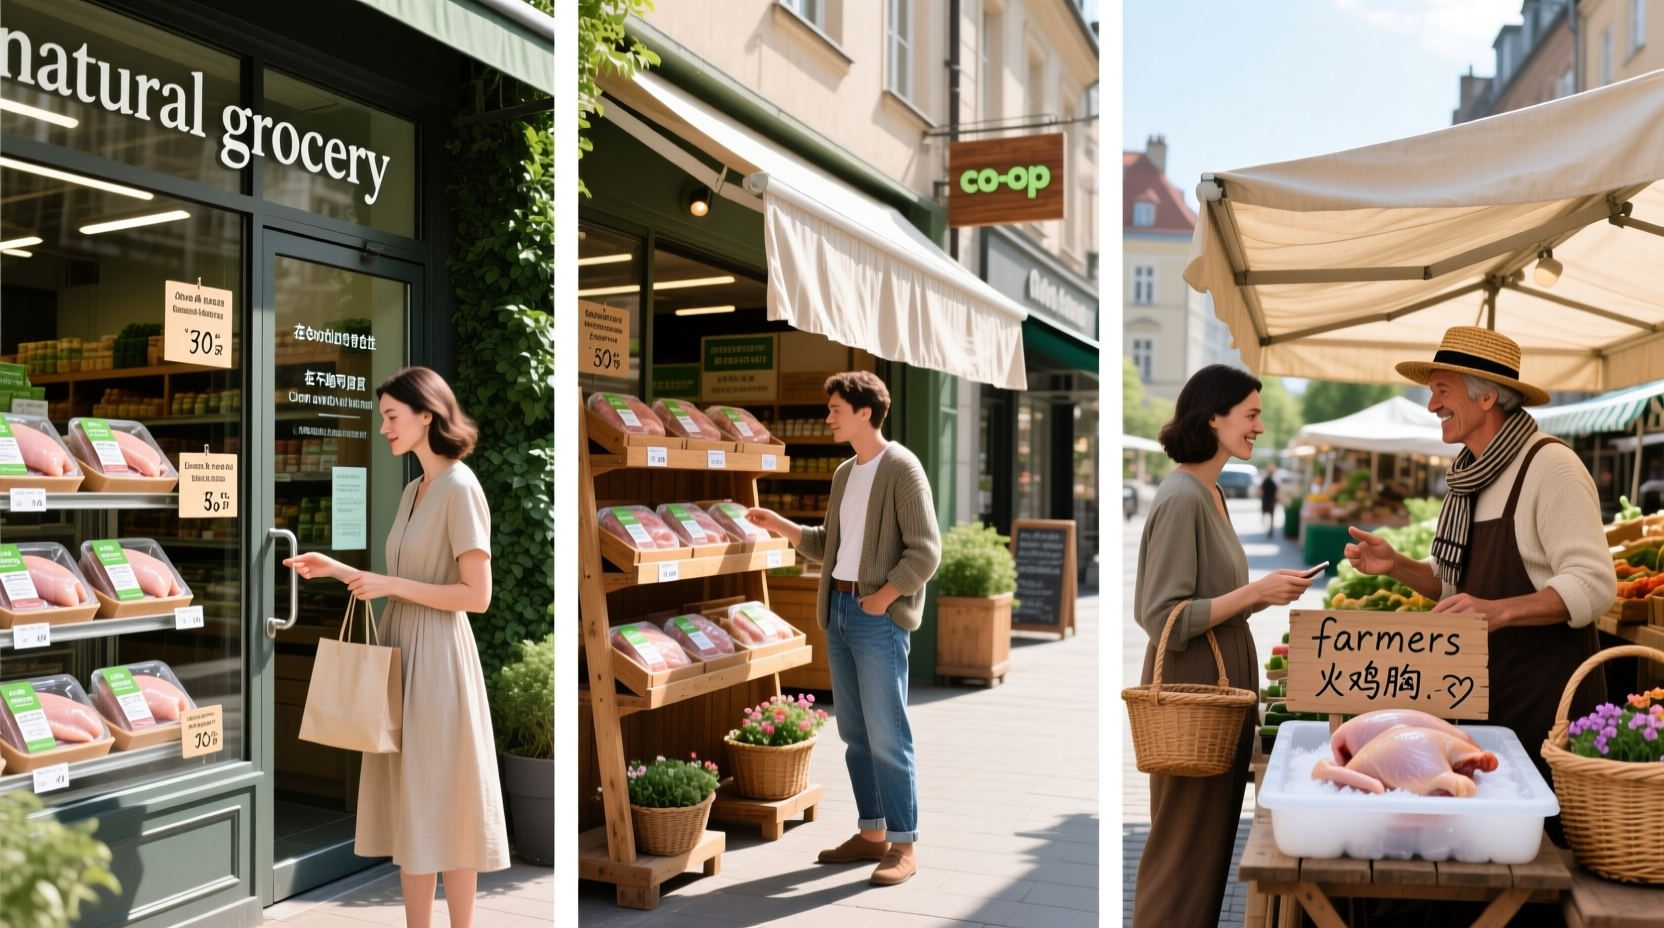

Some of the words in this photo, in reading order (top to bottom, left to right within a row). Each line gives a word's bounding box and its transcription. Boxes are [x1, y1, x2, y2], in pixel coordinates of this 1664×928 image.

[0, 28, 206, 138] natural
[220, 104, 391, 205] grocery
[960, 165, 1051, 199] co-op
[1311, 616, 1460, 659] farmers
